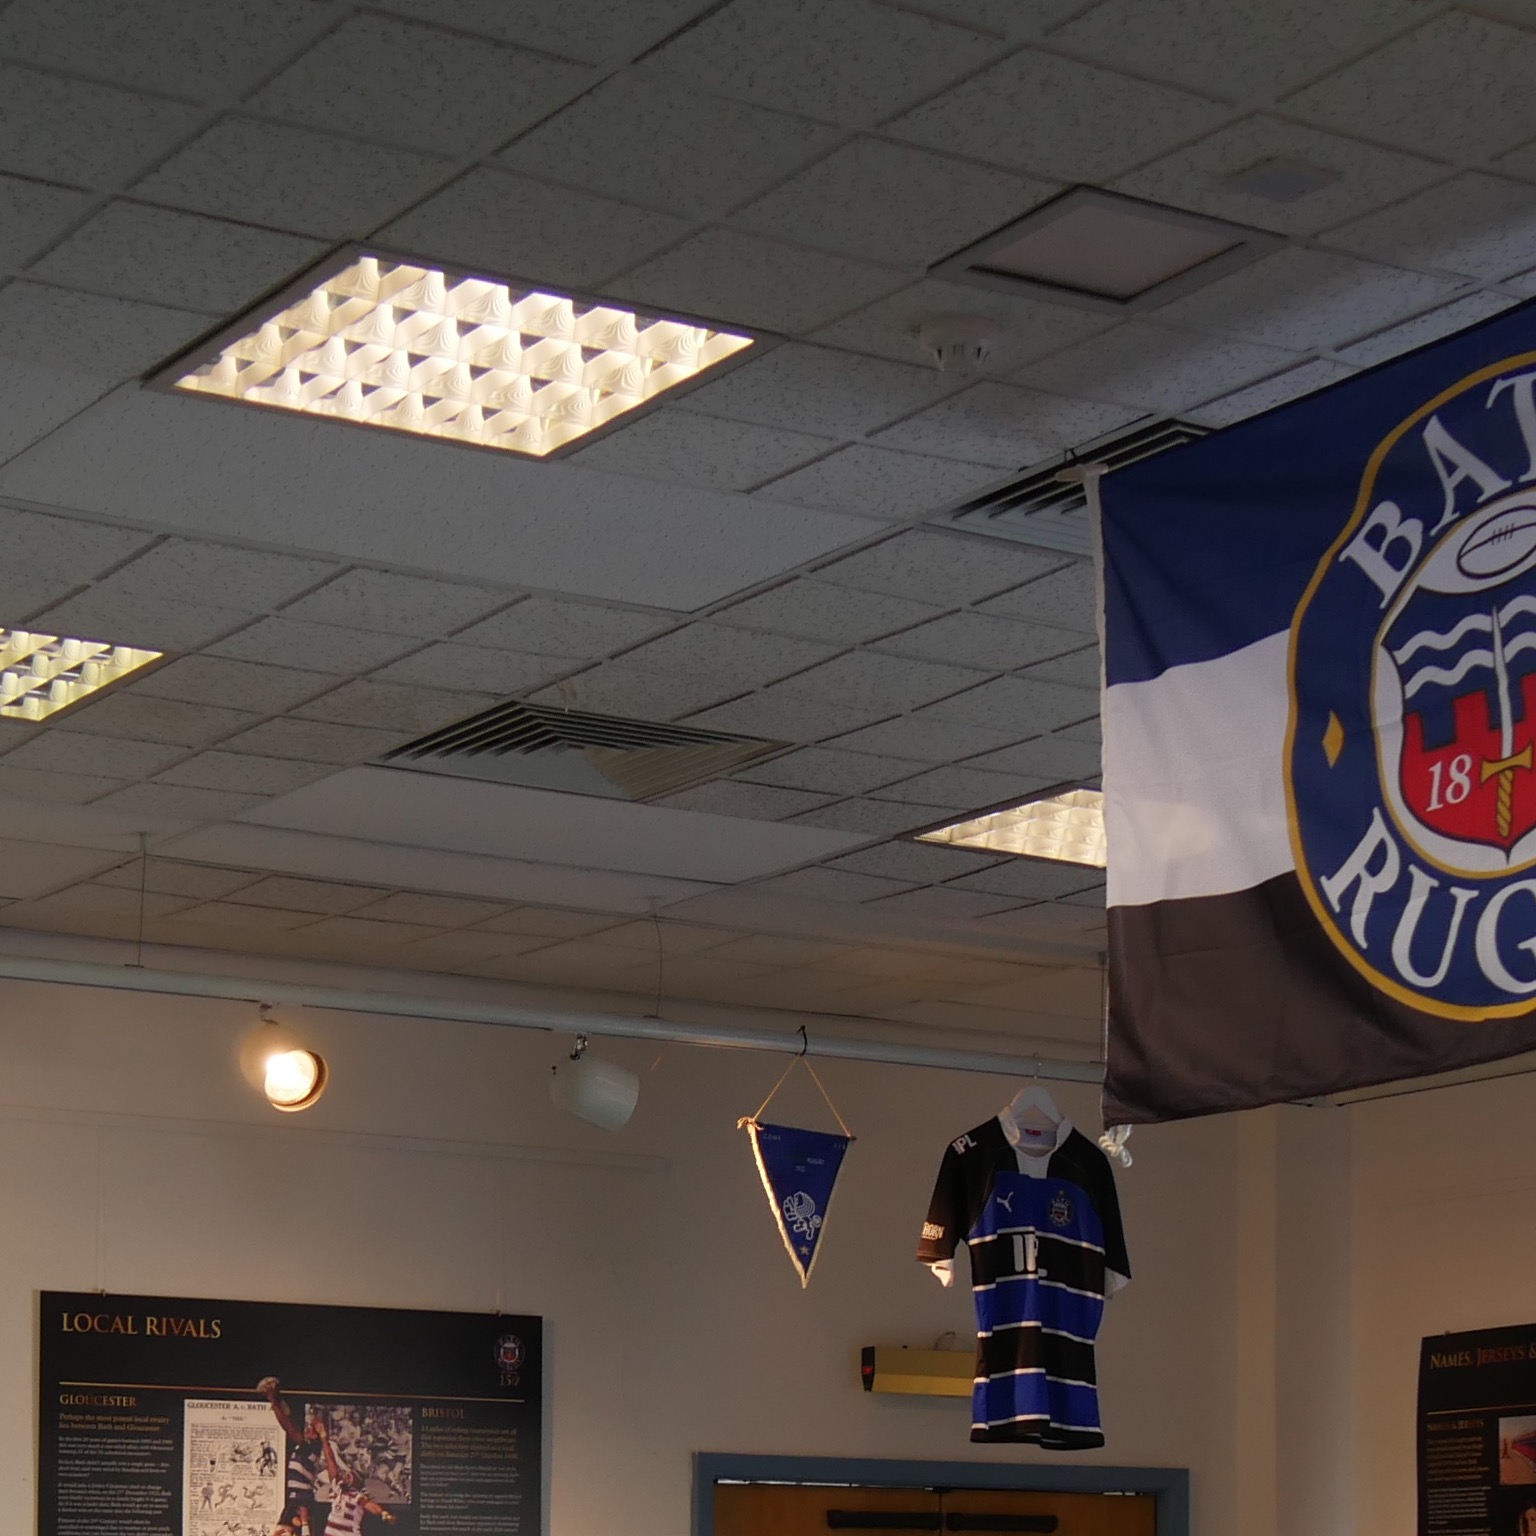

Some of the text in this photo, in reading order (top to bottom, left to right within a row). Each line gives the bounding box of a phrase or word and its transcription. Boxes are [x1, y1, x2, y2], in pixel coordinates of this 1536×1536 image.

[1426, 755, 1472, 813] 18
[951, 1134, 978, 1155] IPL
[61, 1312, 222, 1340] LOCAL RIVALS
[1475, 1343, 1525, 1367] JERSEYS
[59, 1394, 138, 1408] GLOUCESTER
